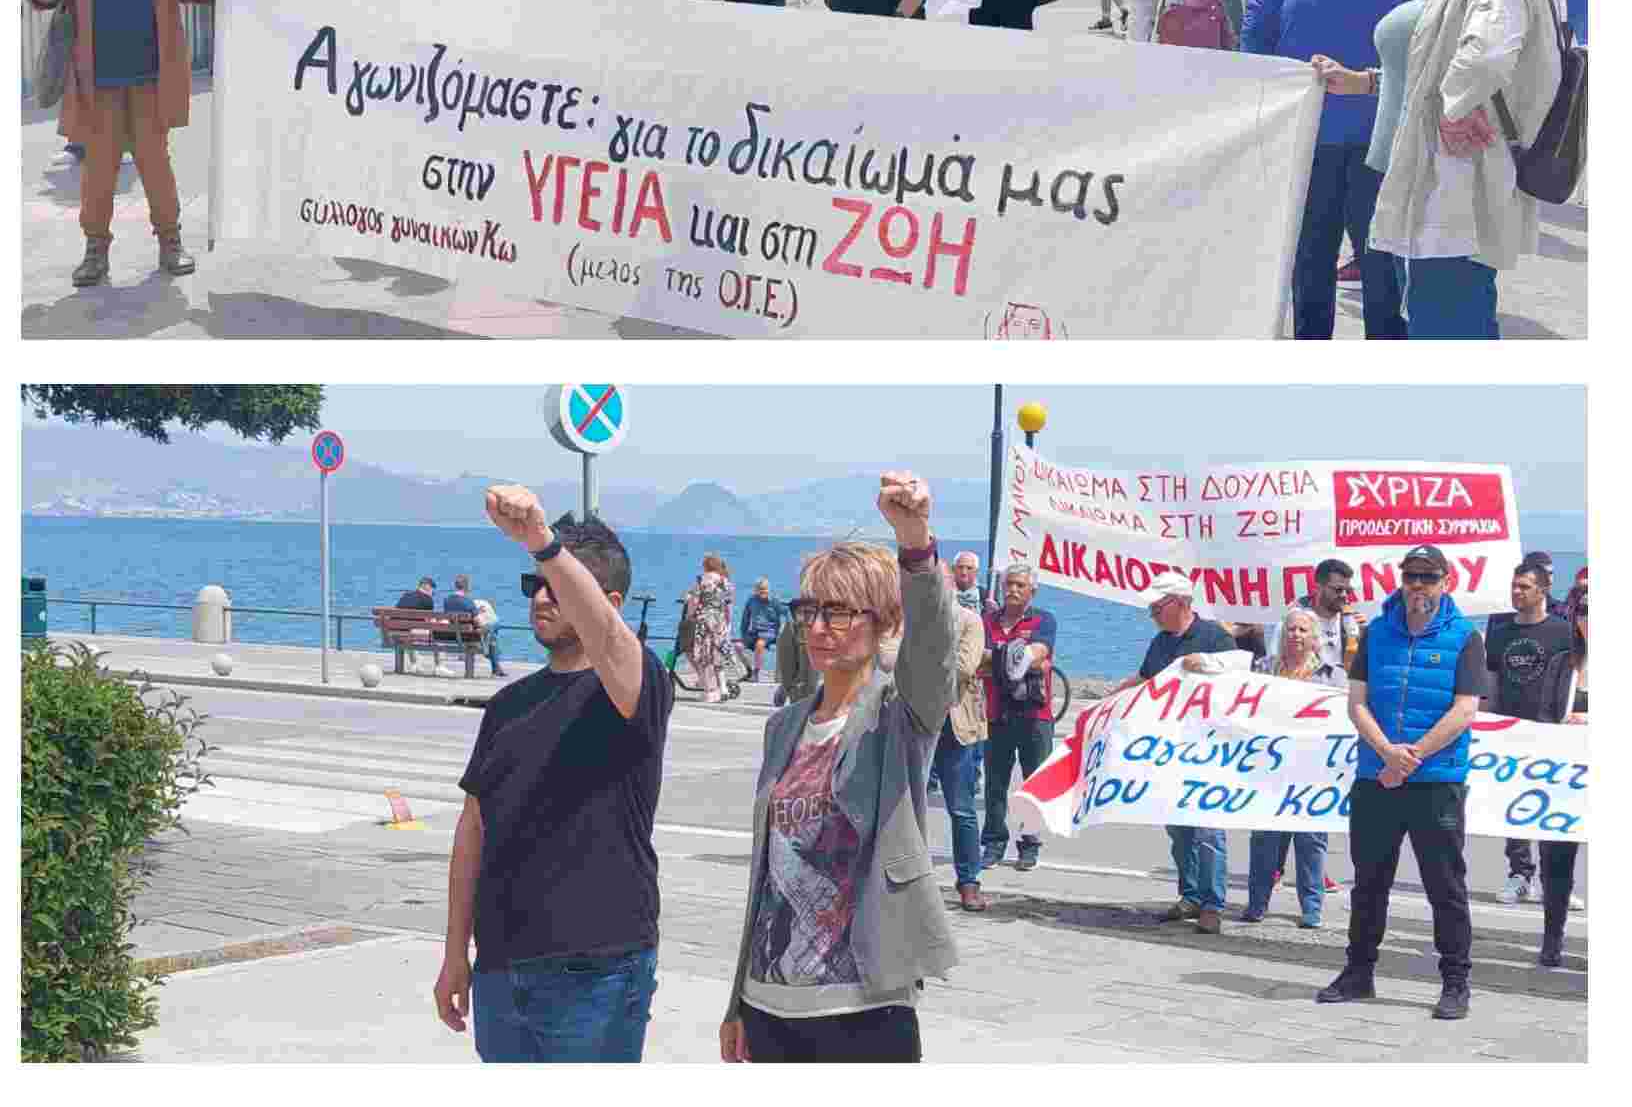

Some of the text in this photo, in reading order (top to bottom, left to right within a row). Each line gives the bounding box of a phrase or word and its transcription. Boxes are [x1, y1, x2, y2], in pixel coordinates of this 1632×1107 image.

[608, 114, 668, 163] για
[685, 125, 721, 167] το
[996, 162, 1126, 225] μας
[422, 155, 496, 201] στην
[523, 149, 673, 244] ΥΓΕΙΑ
[760, 221, 817, 270] στη
[822, 196, 977, 297] ΖΩΗ
[665, 266, 704, 299] της
[1136, 474, 1188, 503] ΣΤΗ
[1200, 469, 1319, 503] ΔΟΥΛΕΙΑ
[1345, 473, 1473, 509] ΣΥΡΙΖΑ
[1159, 514, 1214, 539] ΣΤΗ
[1236, 510, 1302, 538] ΖΩΗ
[1338, 517, 1434, 537] ΠΡΟΟΔΕΥΤΙΚΗ
[1039, 533, 1489, 608] ΔΙΚΑΙΟΝΗ ΠΝΥ
[1121, 677, 1270, 722] ΜΑΗ
[1122, 729, 1292, 774] αγώνες
[1176, 779, 1257, 814] του
